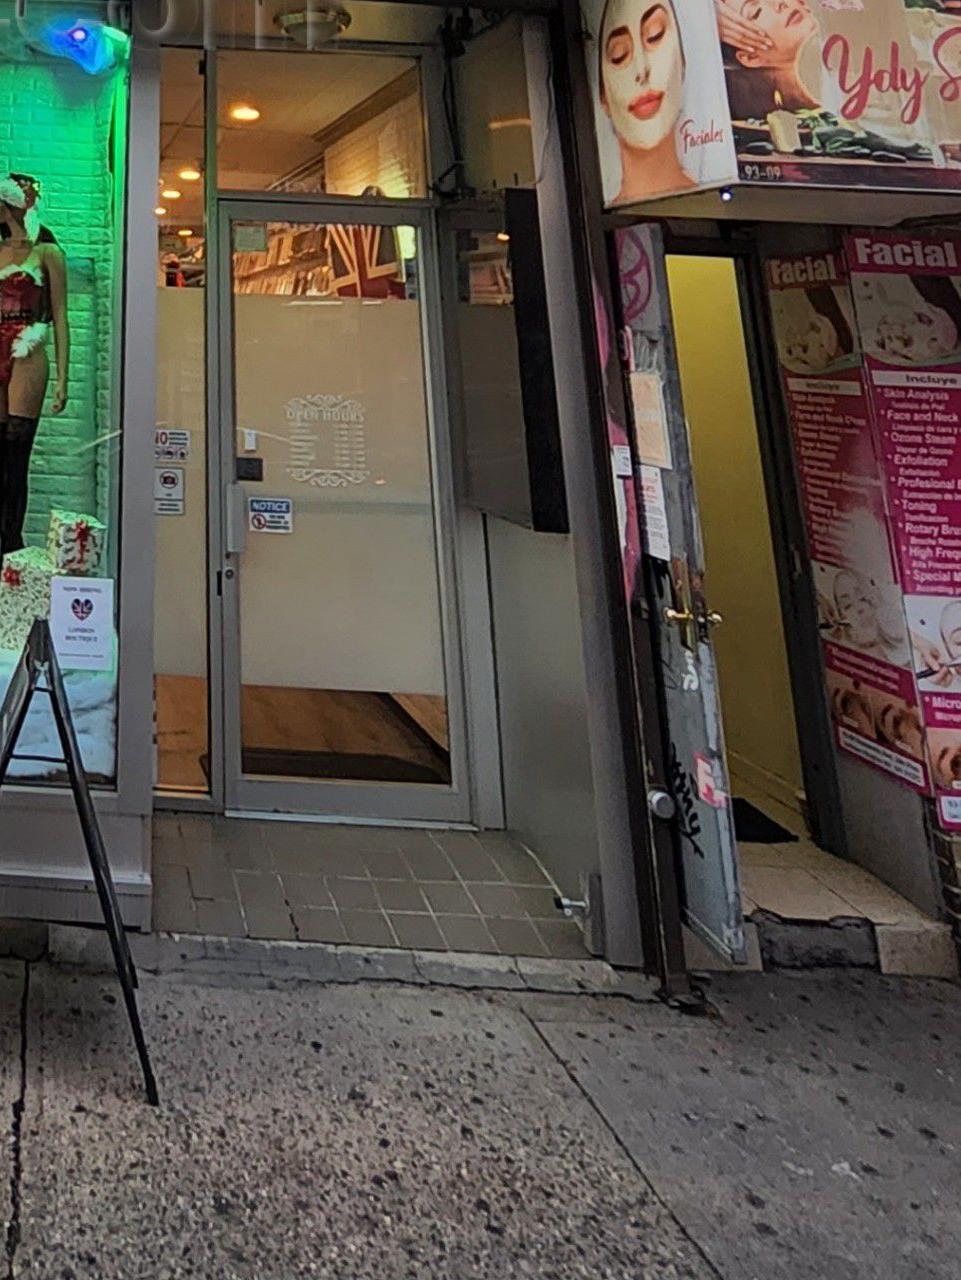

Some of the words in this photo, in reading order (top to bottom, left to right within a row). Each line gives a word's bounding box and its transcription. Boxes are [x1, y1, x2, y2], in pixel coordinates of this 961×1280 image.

[680, 120, 724, 155] Faciales
[744, 165, 781, 180] 93-09
[855, 237, 958, 268] Facial
[771, 254, 836, 285] Facial
[905, 374, 957, 386] Incluye
[884, 388, 905, 398] Skin
[887, 410, 911, 420] Face
[913, 411, 932, 421] and
[252, 501, 288, 512] NOTICE
[901, 499, 937, 513] Toning
[905, 523, 939, 537] Rotary
[909, 546, 934, 560] High
